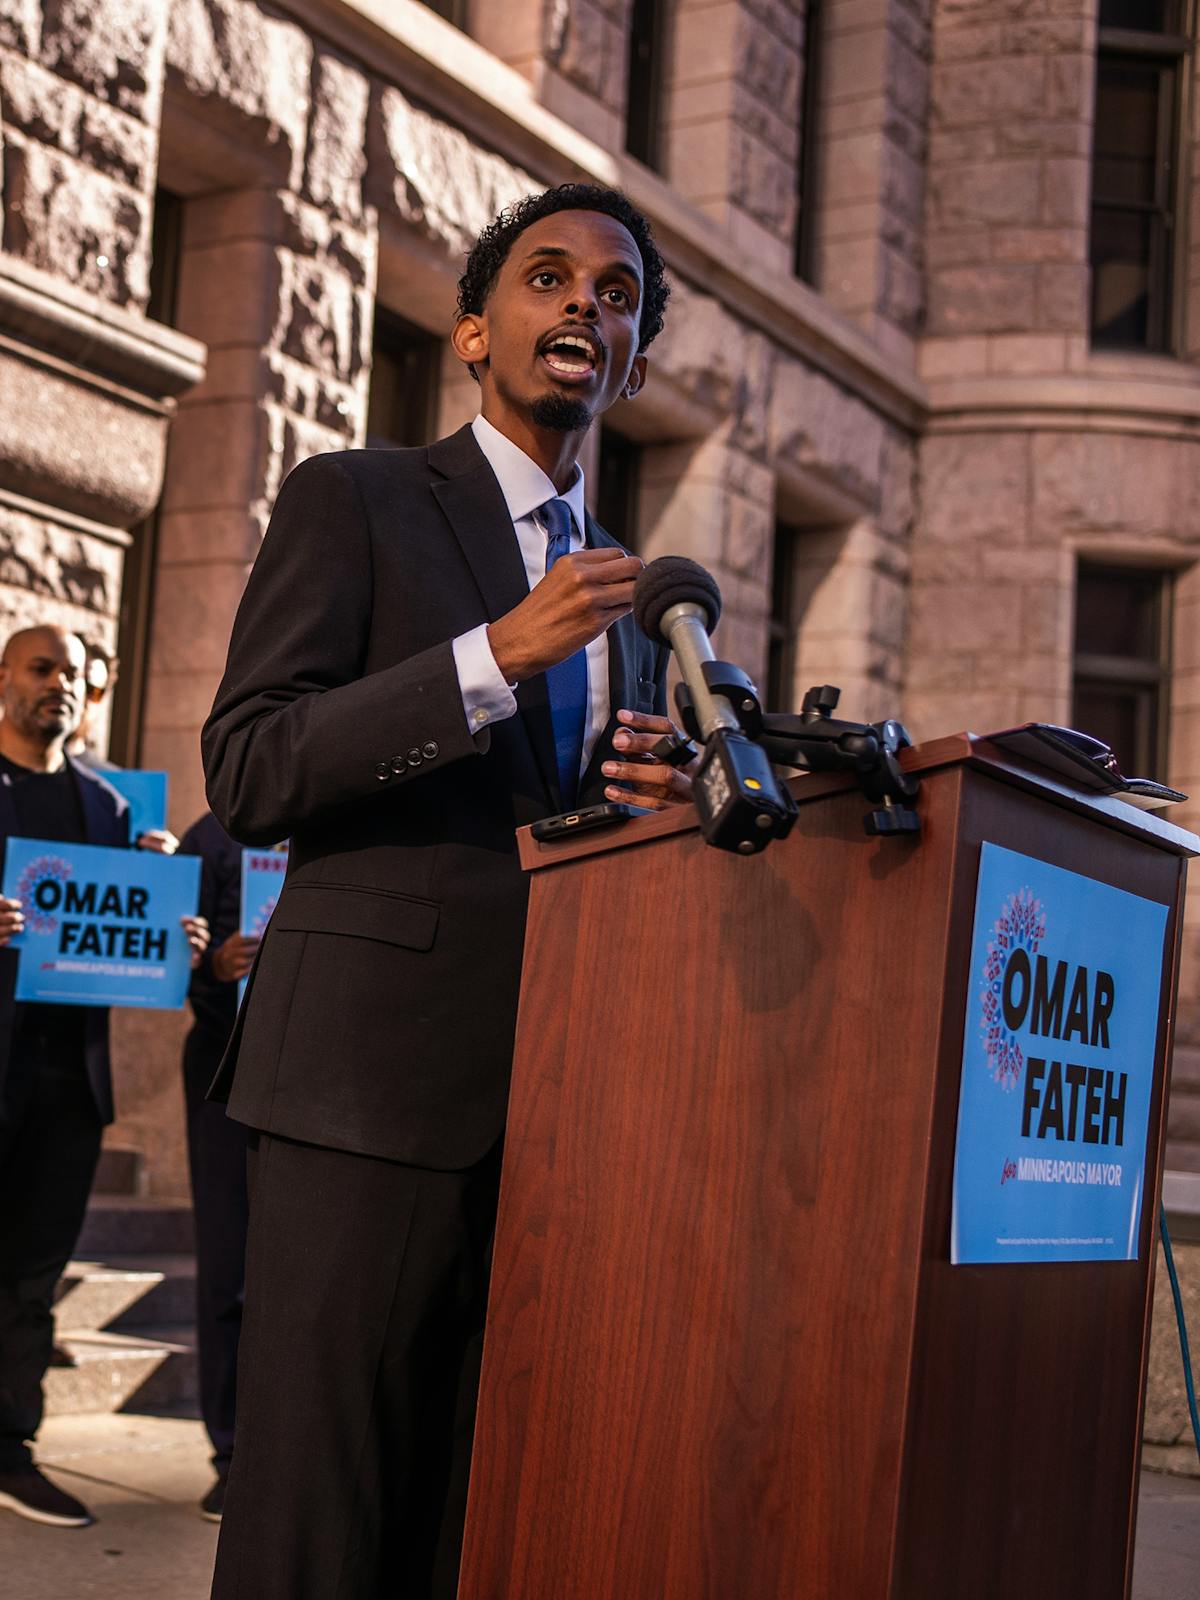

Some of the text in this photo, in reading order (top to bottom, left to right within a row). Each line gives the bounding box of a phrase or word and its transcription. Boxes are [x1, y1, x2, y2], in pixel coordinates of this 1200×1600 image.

[35, 879, 148, 919] OMAR
[58, 923, 168, 961] FATEH
[1002, 947, 1115, 1049] OMAR
[1020, 1056, 1128, 1147] FATEH
[1000, 1157, 1122, 1186] for MINNEAPOLIS MAYOR
